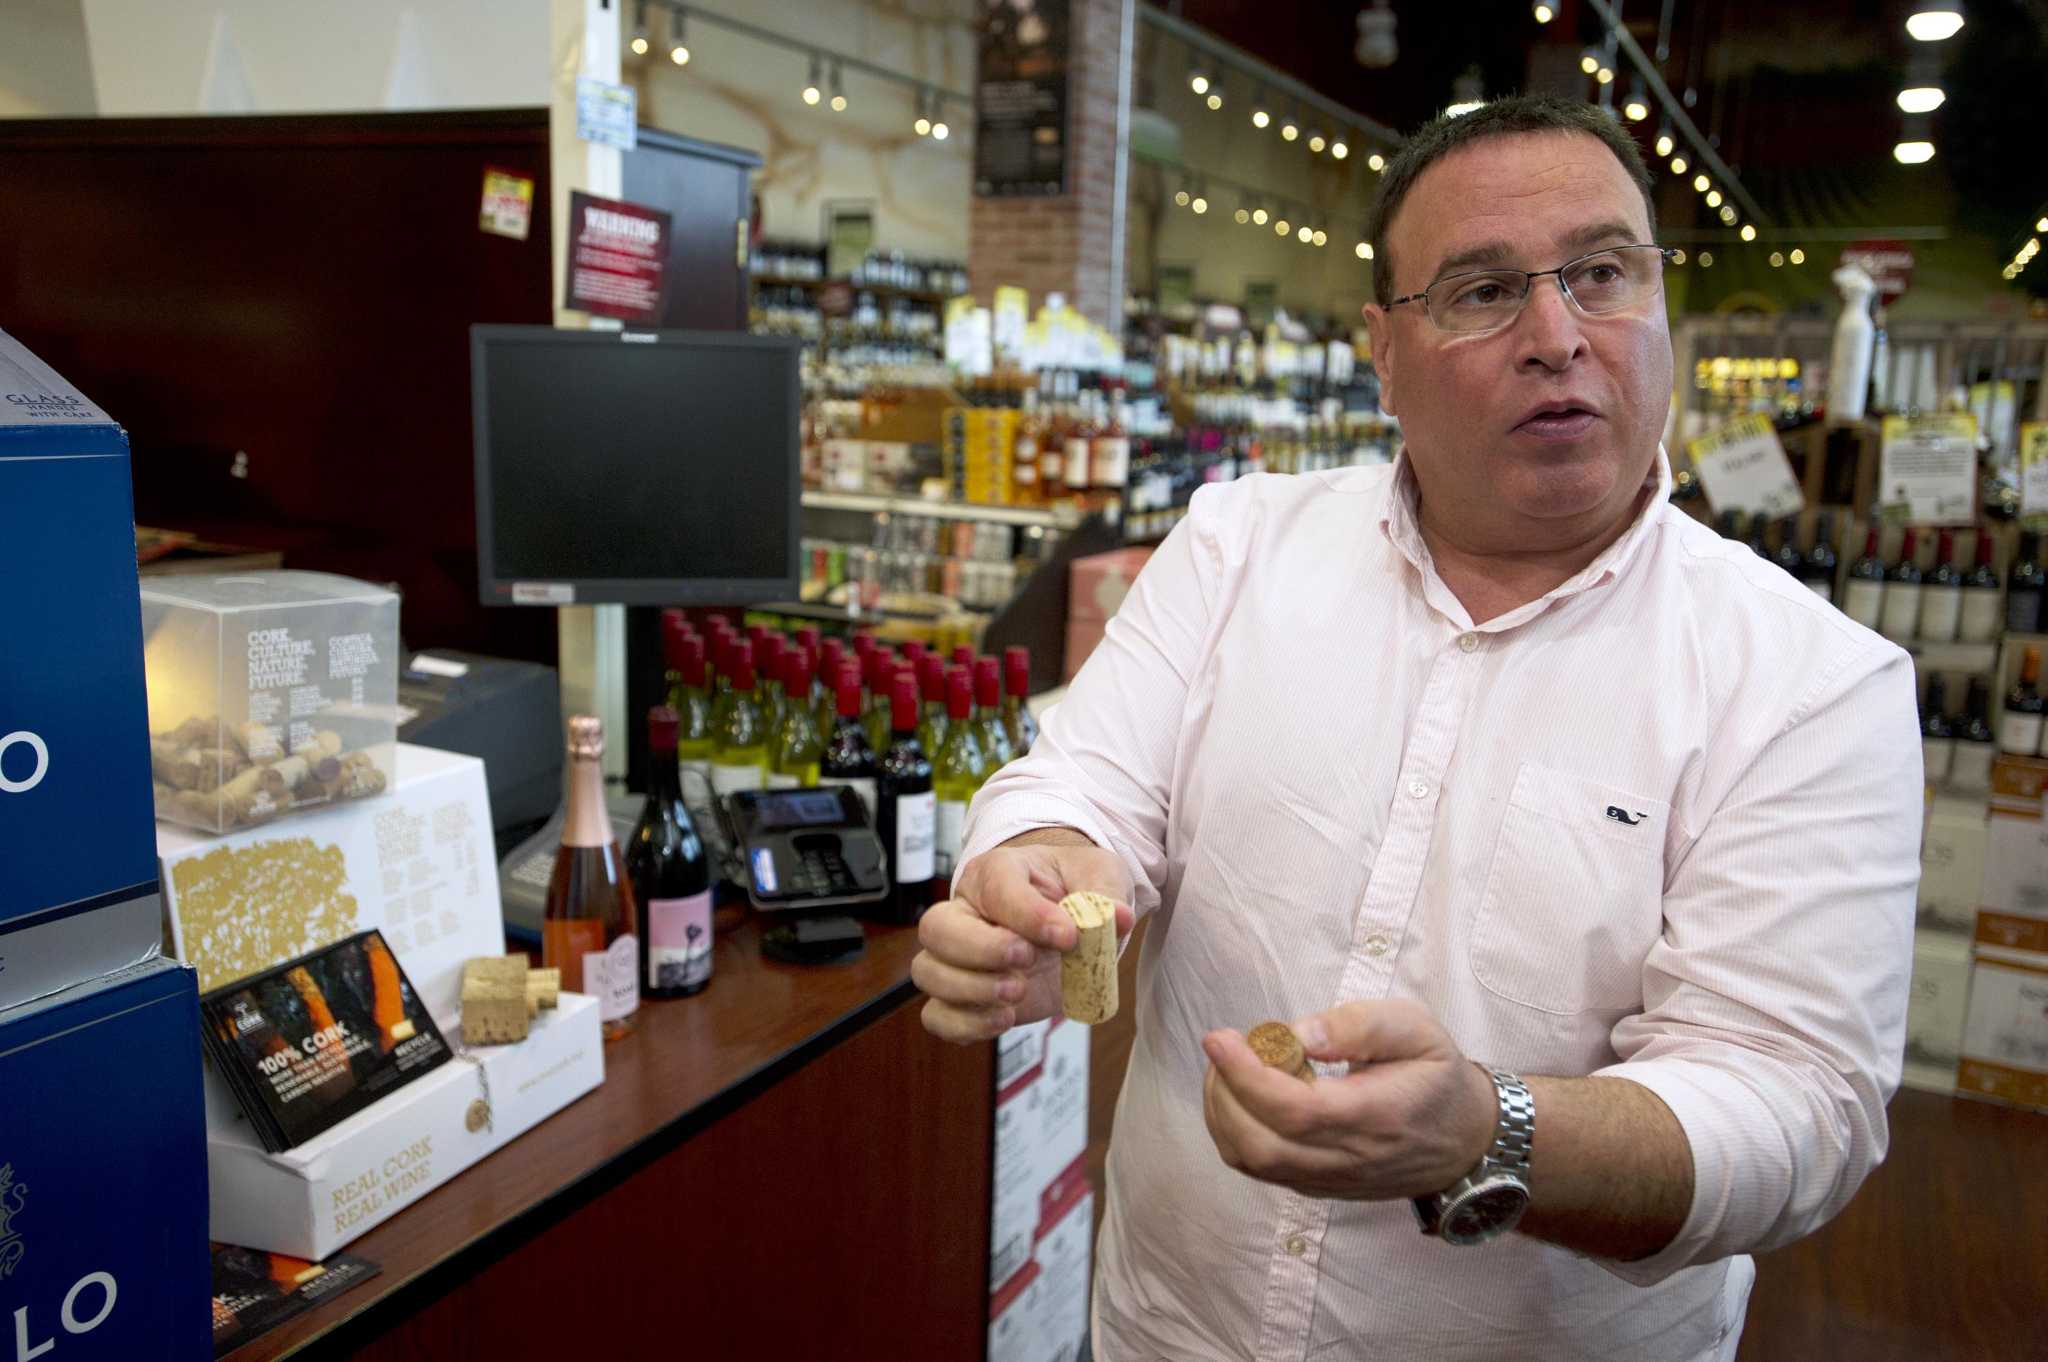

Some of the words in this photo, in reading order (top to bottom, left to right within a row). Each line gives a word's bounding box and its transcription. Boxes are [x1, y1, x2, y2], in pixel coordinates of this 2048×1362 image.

[6, 393, 80, 404] GLASS
[257, 1045, 303, 1076] 100%
[302, 1020, 351, 1054] CORK
[332, 1167, 381, 1210] REAL
[383, 1135, 432, 1179] CORK
[335, 1194, 382, 1234] REAL
[384, 1160, 432, 1200] WINE
